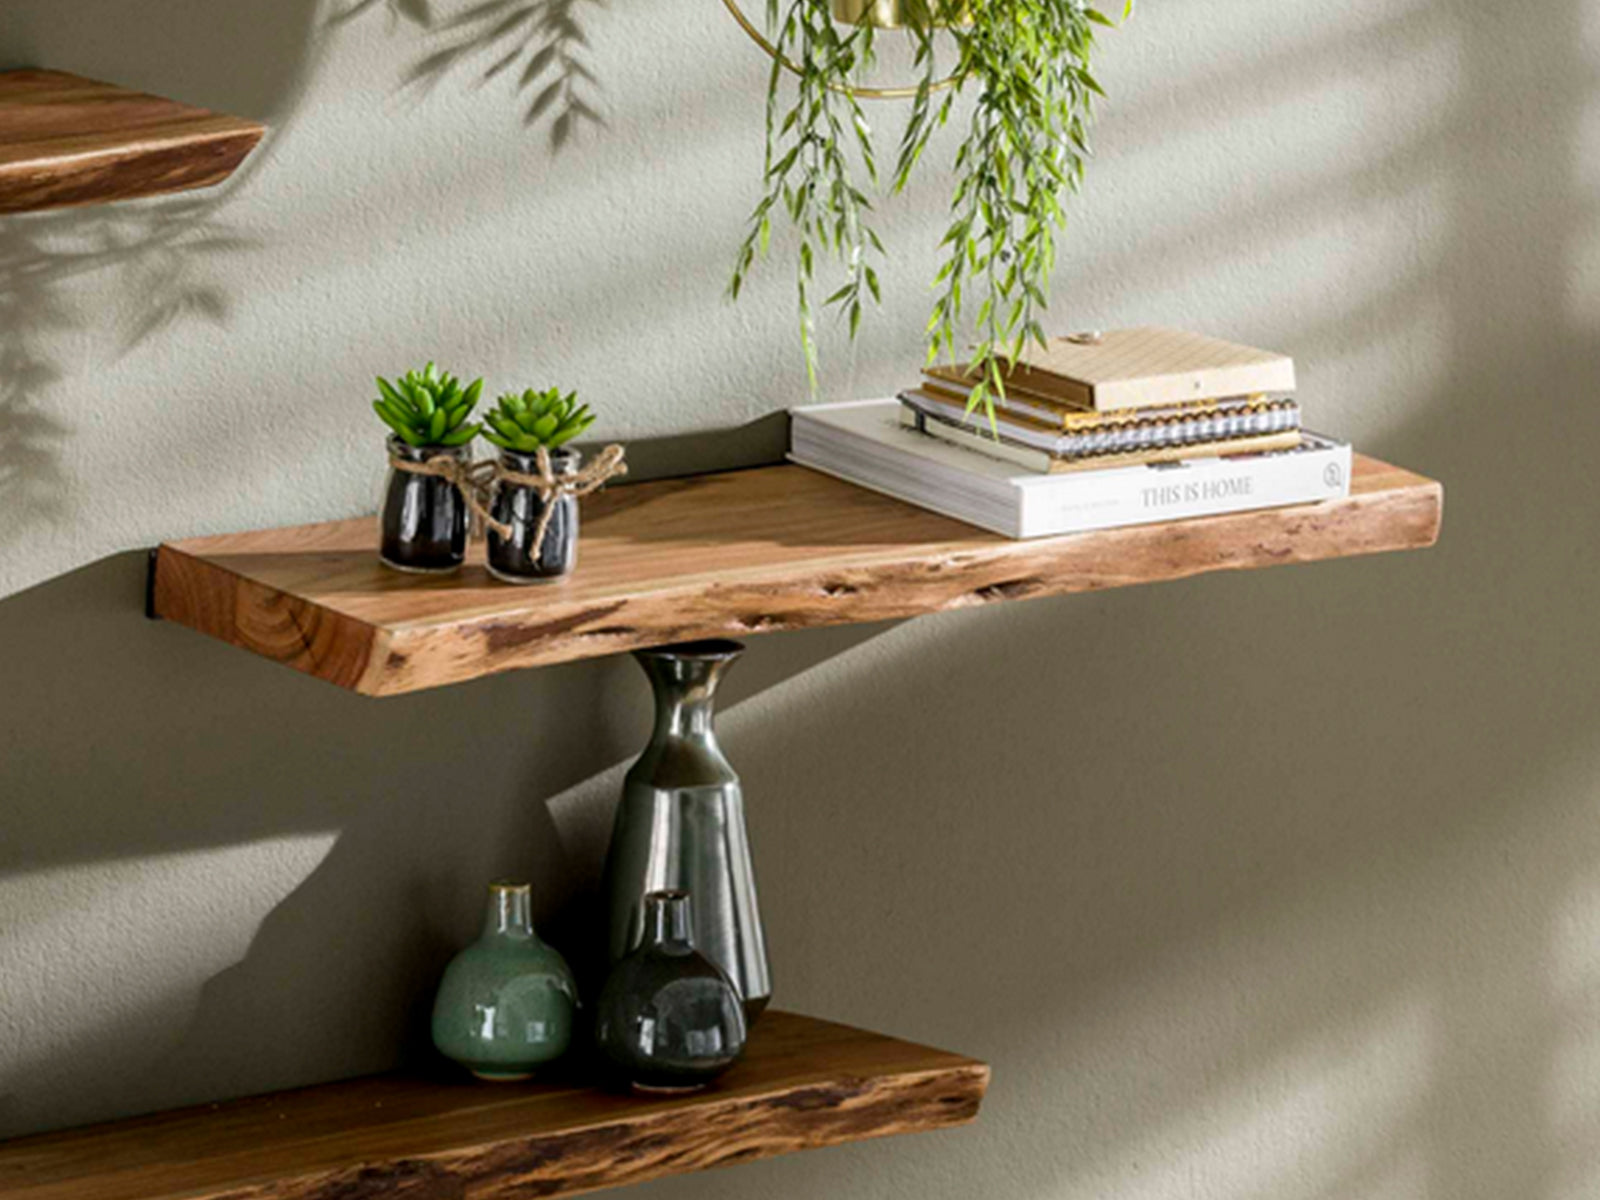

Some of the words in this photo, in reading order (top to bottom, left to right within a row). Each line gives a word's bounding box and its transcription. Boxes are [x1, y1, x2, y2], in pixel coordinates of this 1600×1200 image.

[1142, 483, 1181, 507] THIS
[1184, 481, 1199, 500] IS
[1202, 476, 1254, 499] HOME
